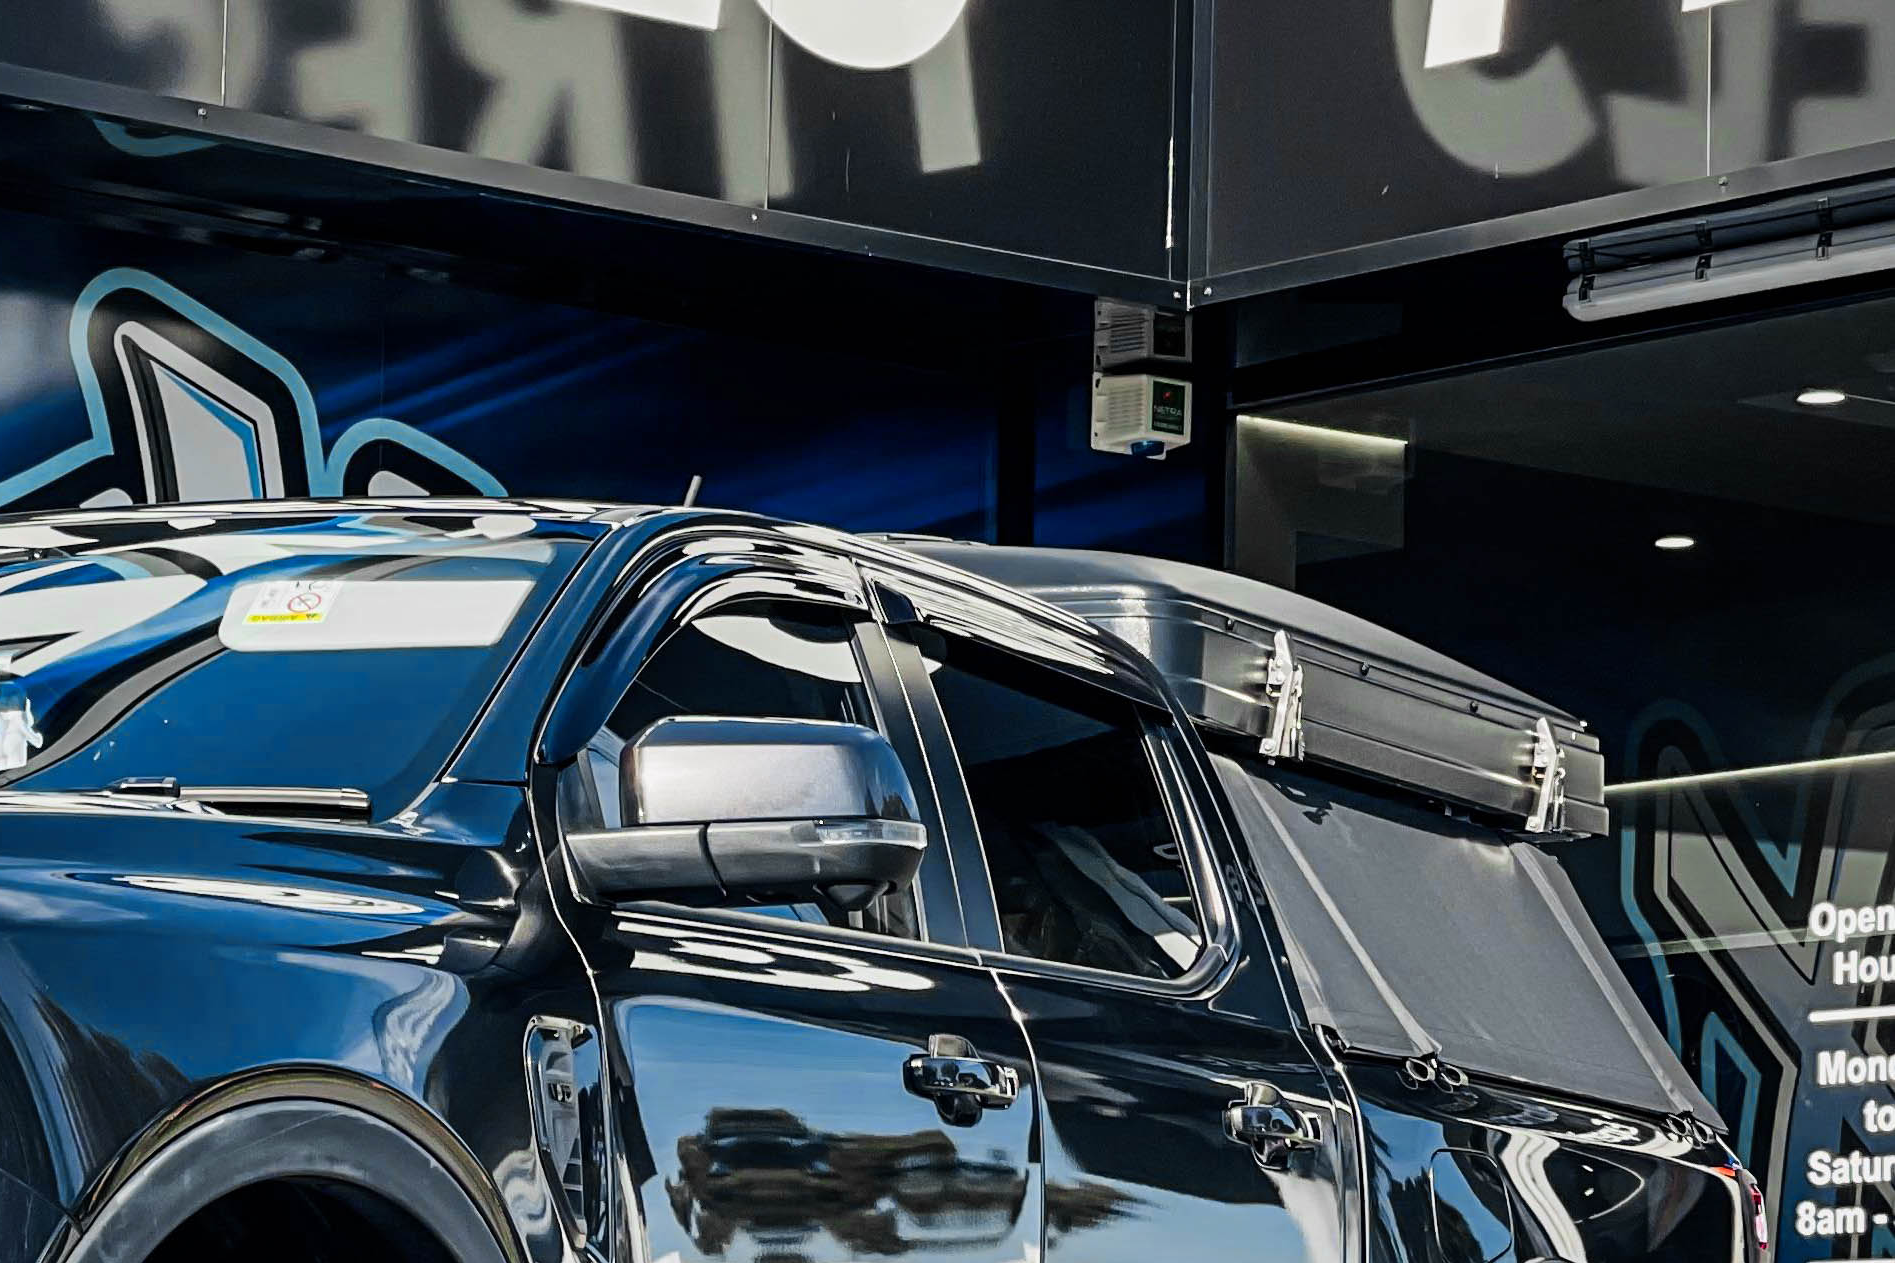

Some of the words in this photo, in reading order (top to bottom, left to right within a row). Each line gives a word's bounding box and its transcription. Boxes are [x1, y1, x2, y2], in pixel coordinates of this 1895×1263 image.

[1809, 902, 1895, 943] Open
[1833, 949, 1895, 985] Hou
[1863, 1099, 1895, 1132] to
[1795, 1200, 1866, 1236] 8am
